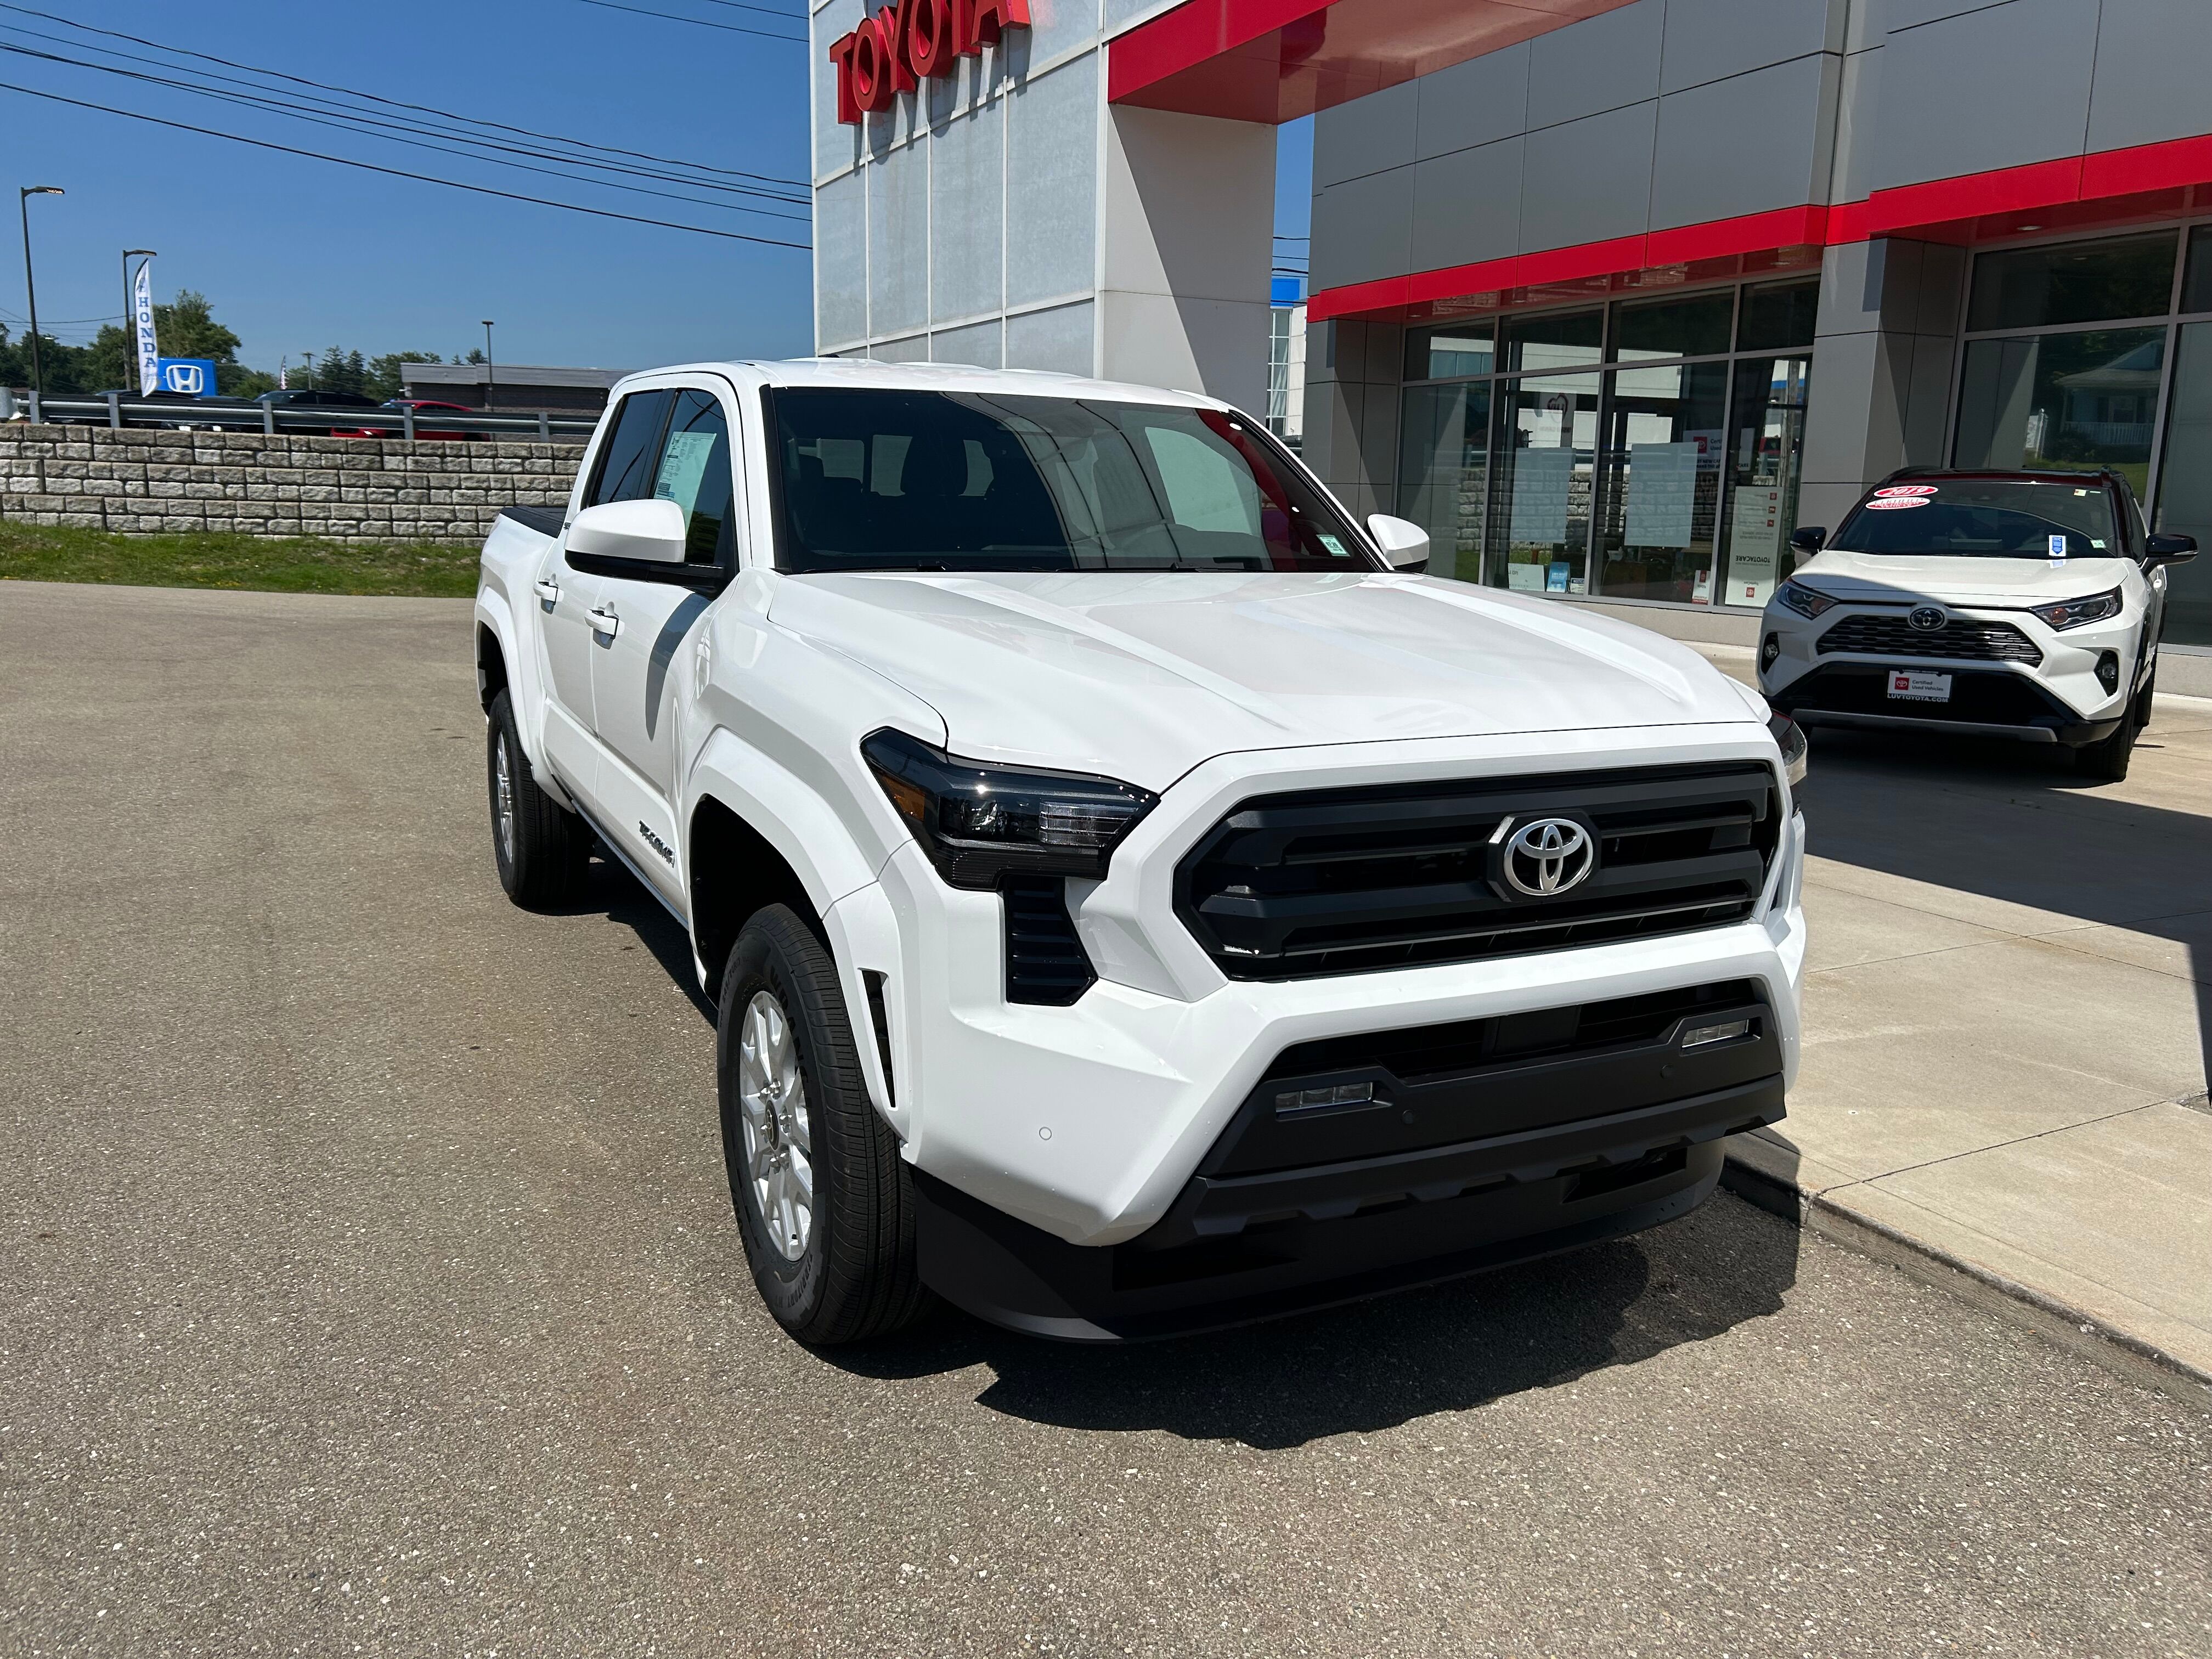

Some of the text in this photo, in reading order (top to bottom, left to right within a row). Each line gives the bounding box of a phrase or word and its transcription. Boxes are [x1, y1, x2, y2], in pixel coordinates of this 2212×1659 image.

[138, 297, 156, 368] HONDA
[1882, 487, 1929, 495] 2019
[1735, 555, 1770, 563] TOYOTACARE
[1887, 693, 1948, 702] LUVTOYOTA.COM
